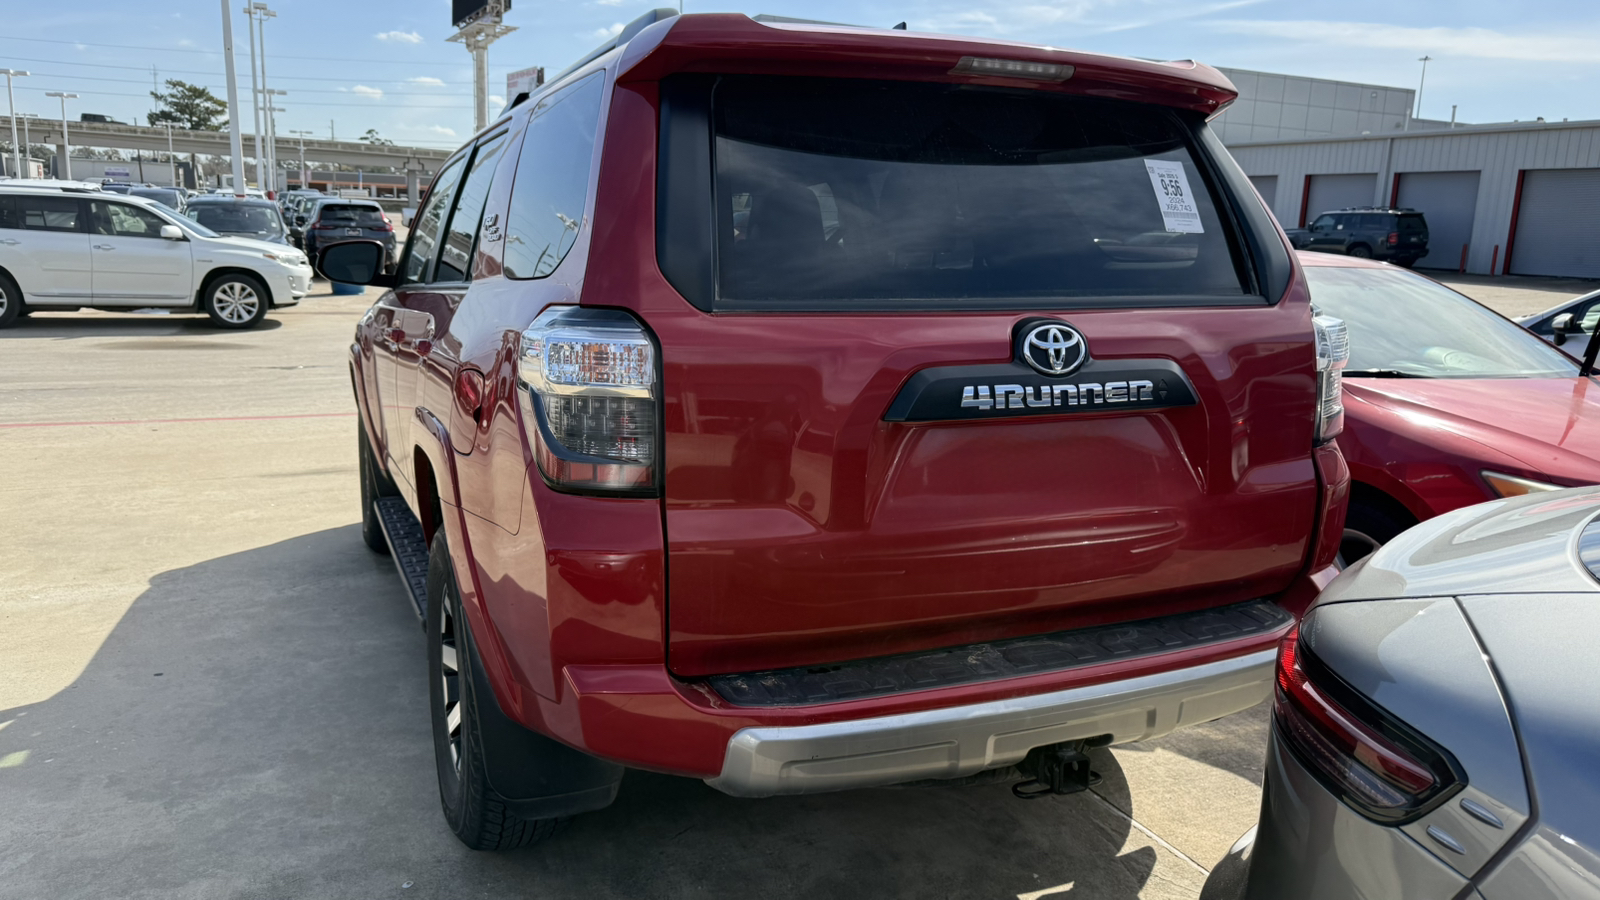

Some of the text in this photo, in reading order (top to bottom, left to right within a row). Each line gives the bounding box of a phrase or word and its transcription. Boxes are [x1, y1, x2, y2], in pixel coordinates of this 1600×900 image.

[1160, 178, 1183, 197] 9:56
[1168, 196, 1185, 204] 2024
[960, 379, 1154, 410] 4RUNNER
